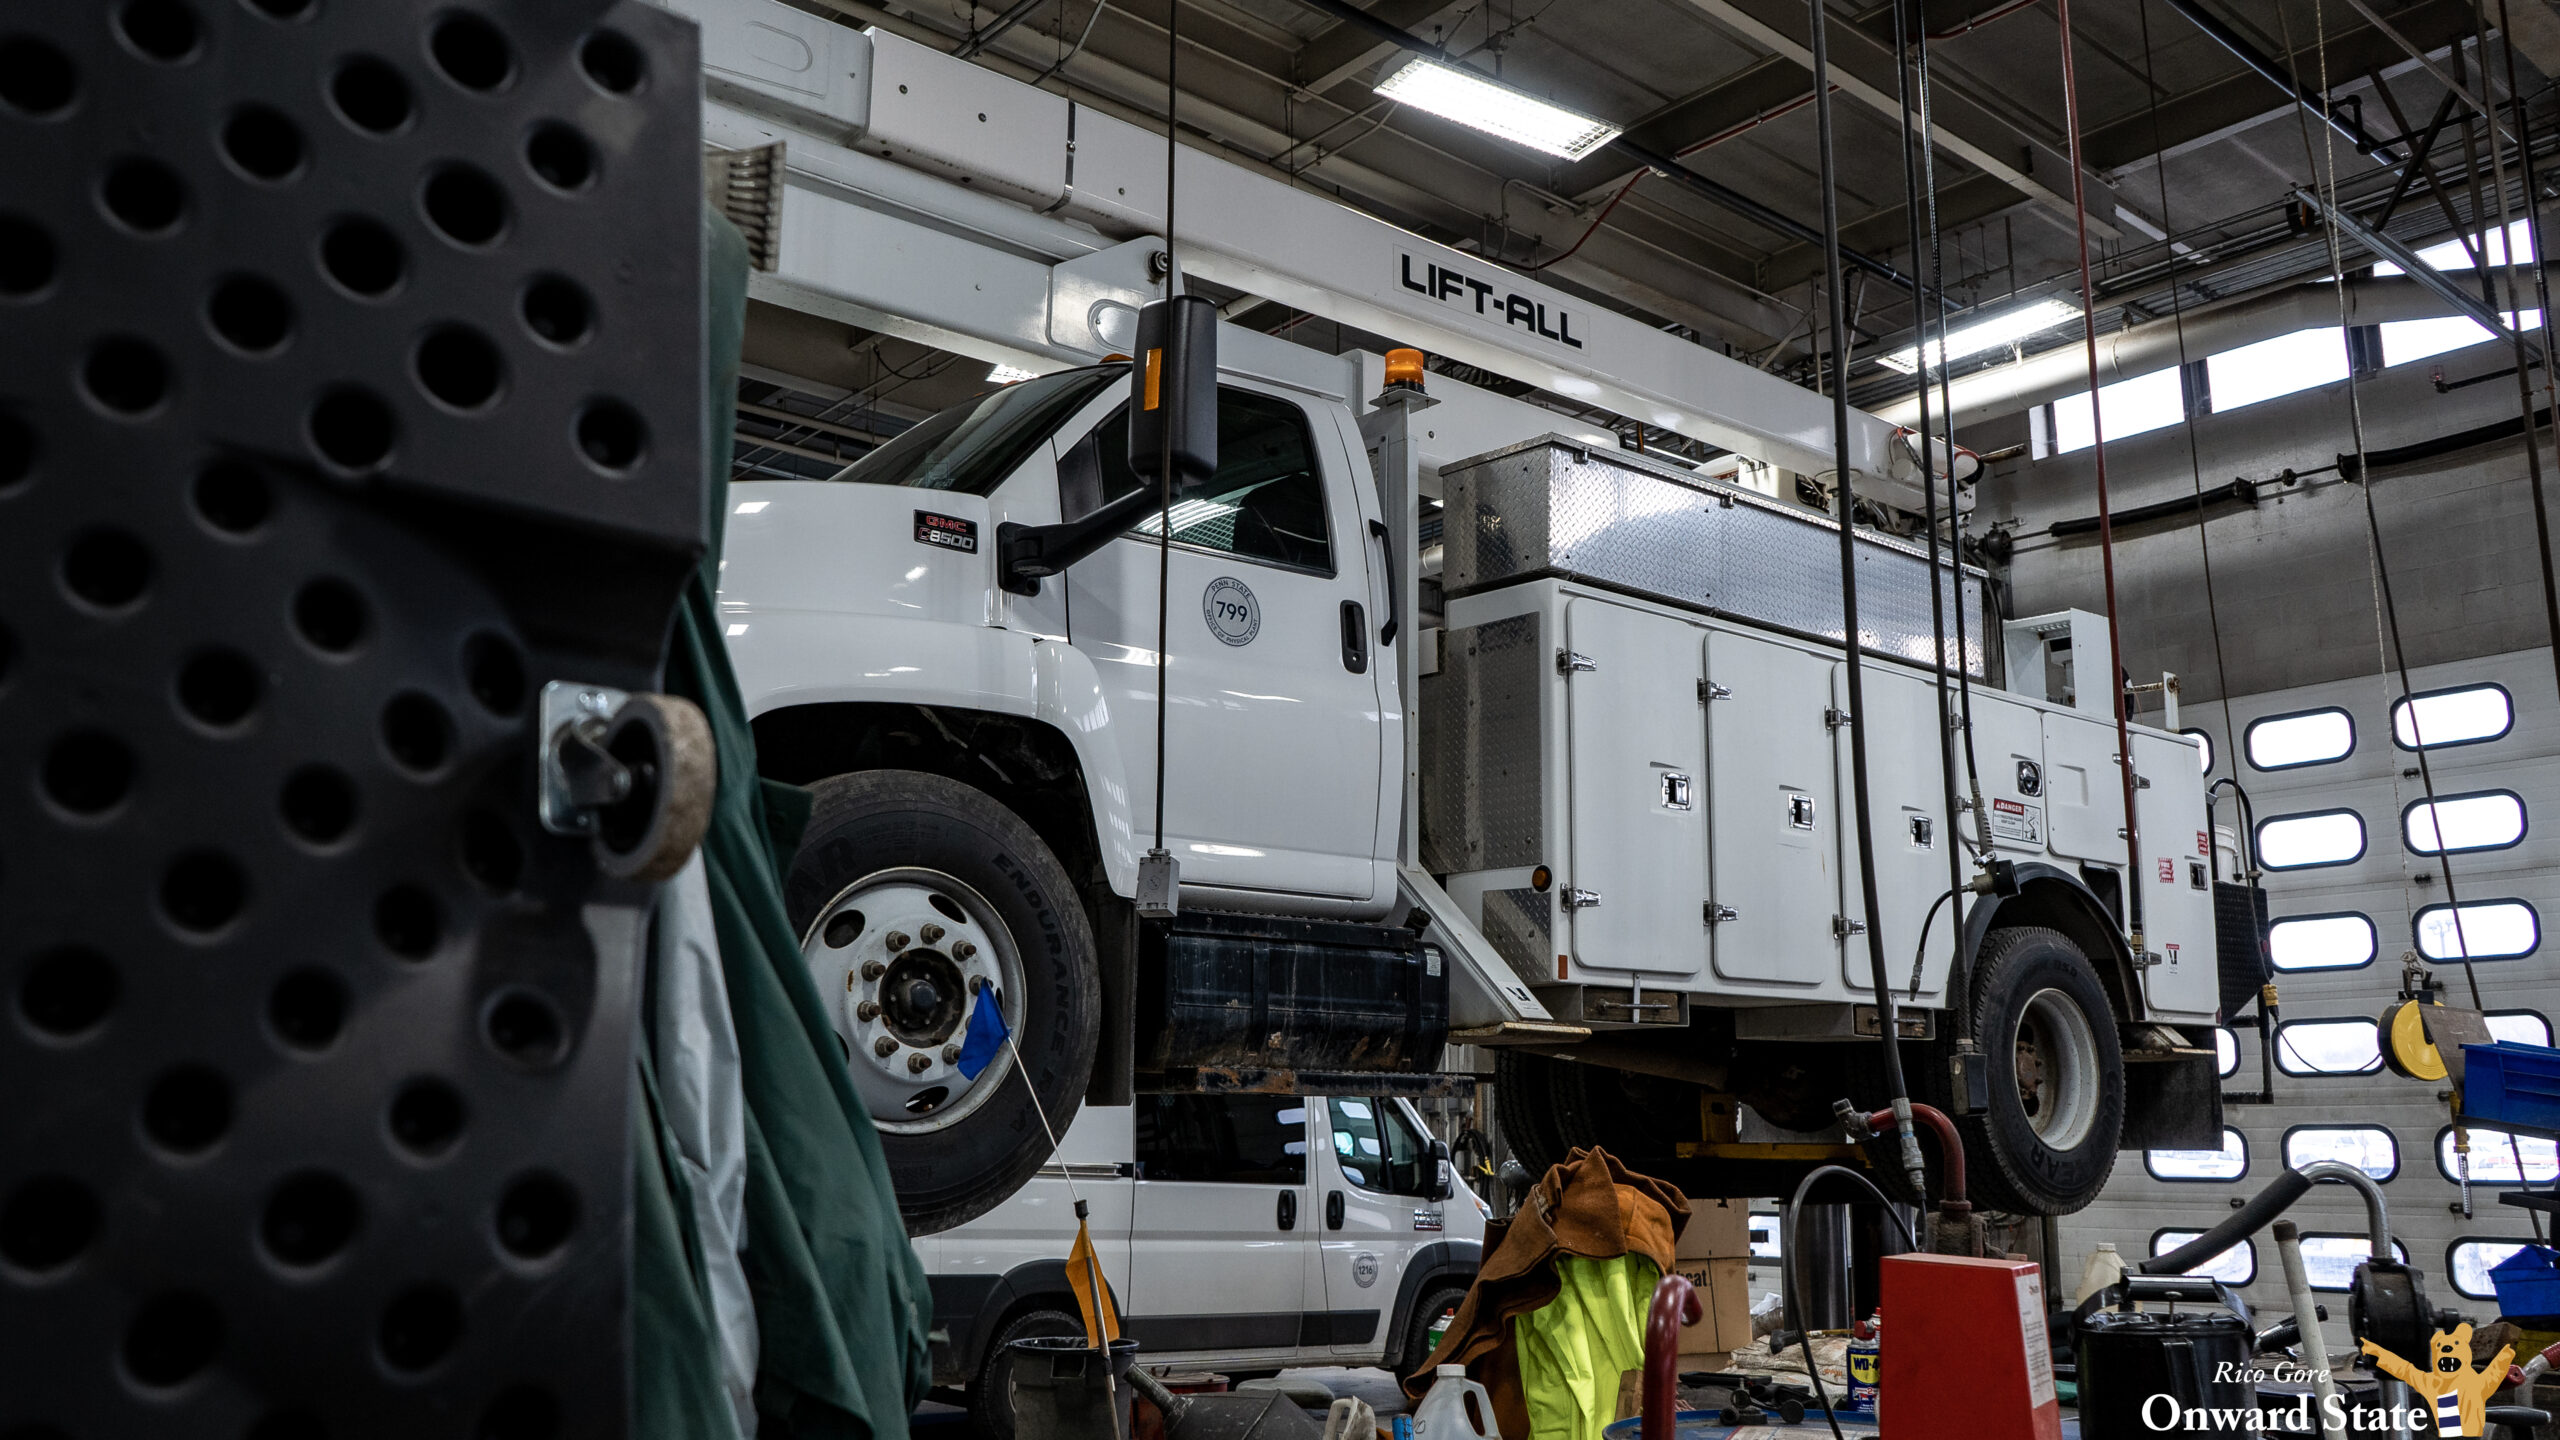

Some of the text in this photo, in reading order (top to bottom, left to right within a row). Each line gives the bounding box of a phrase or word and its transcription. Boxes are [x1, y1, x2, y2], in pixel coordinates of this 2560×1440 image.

[1401, 253, 1582, 350] LIFT-ALL
[926, 515, 967, 533] GMC
[918, 527, 975, 550] C8500
[1210, 580, 1252, 599] PENN STATE
[1216, 600, 1248, 622] 799
[2000, 801, 2023, 813] DANGER
[991, 853, 1069, 1057] ENDURANCE
[1358, 1265, 1373, 1275] 1216
[1853, 1357, 1879, 1371] WD-4
